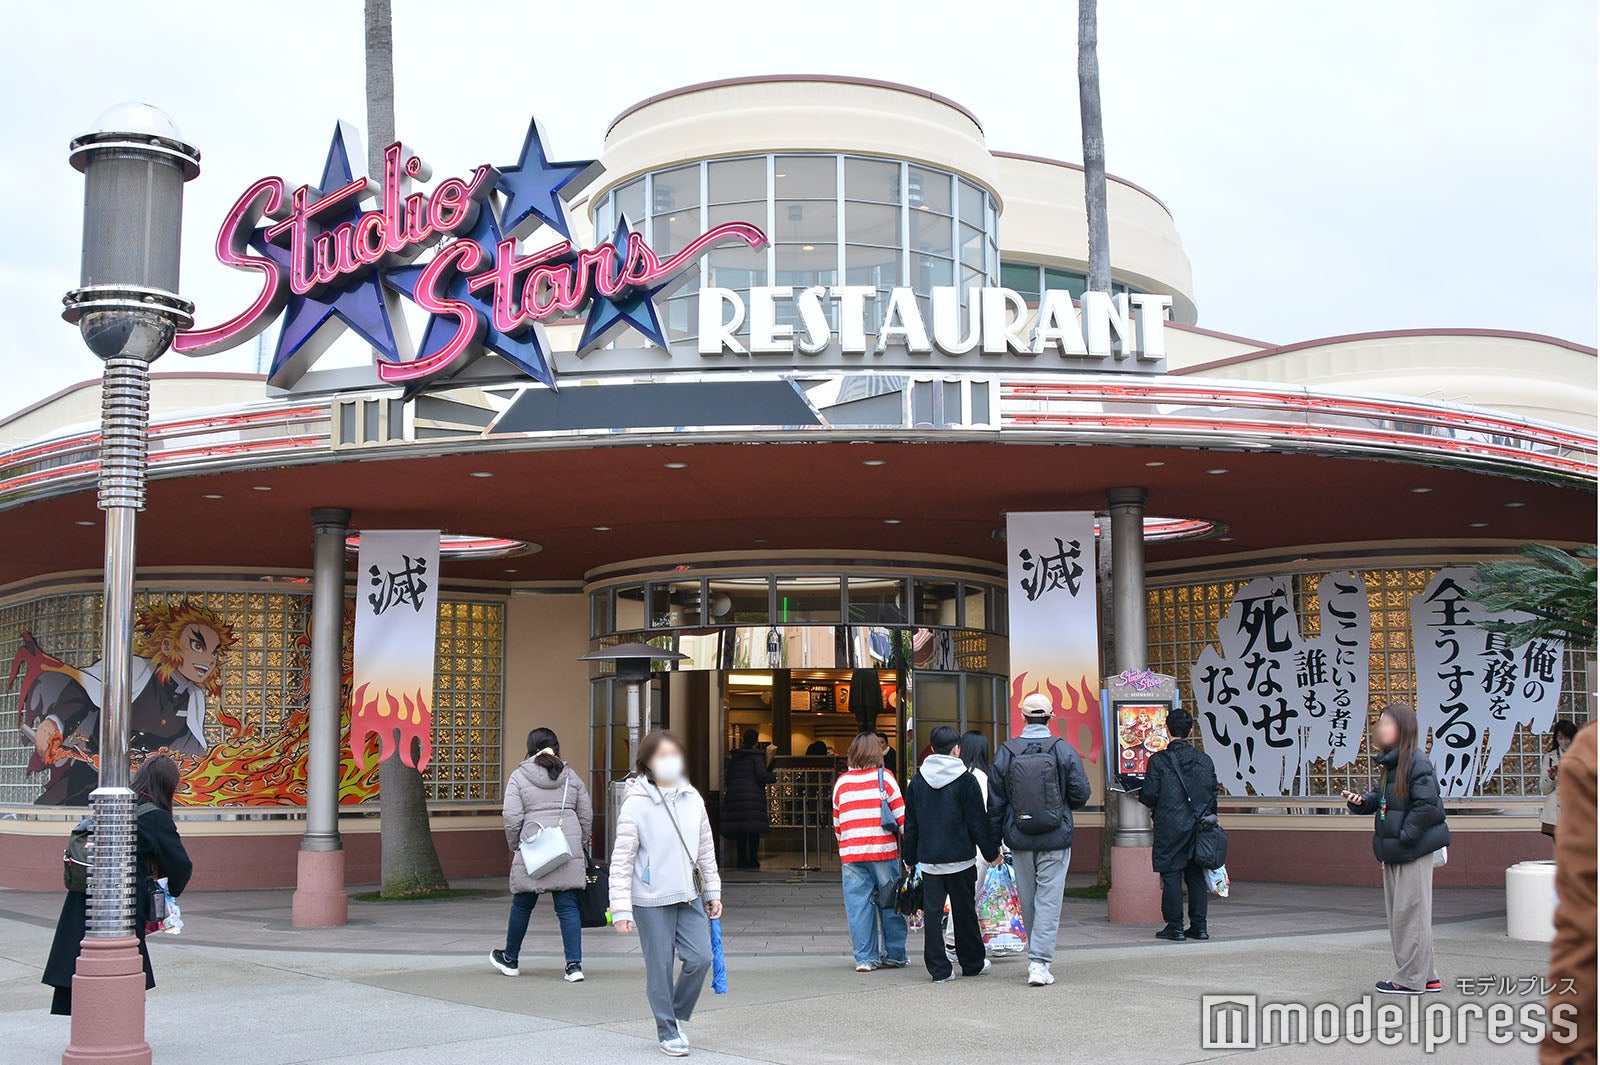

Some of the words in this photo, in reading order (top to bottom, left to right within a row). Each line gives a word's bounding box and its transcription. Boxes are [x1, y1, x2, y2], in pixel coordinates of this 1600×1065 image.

[172, 142, 490, 356] Studio
[377, 220, 769, 382] Stars
[699, 286, 1172, 361] RESTAURANT
[368, 554, 428, 616] 滅
[1019, 537, 1084, 602] 滅
[1236, 587, 1298, 748] 死なせ
[1293, 649, 1329, 718] 誰も
[1328, 582, 1358, 748] ここにいる者は
[1522, 641, 1557, 702] 俺の
